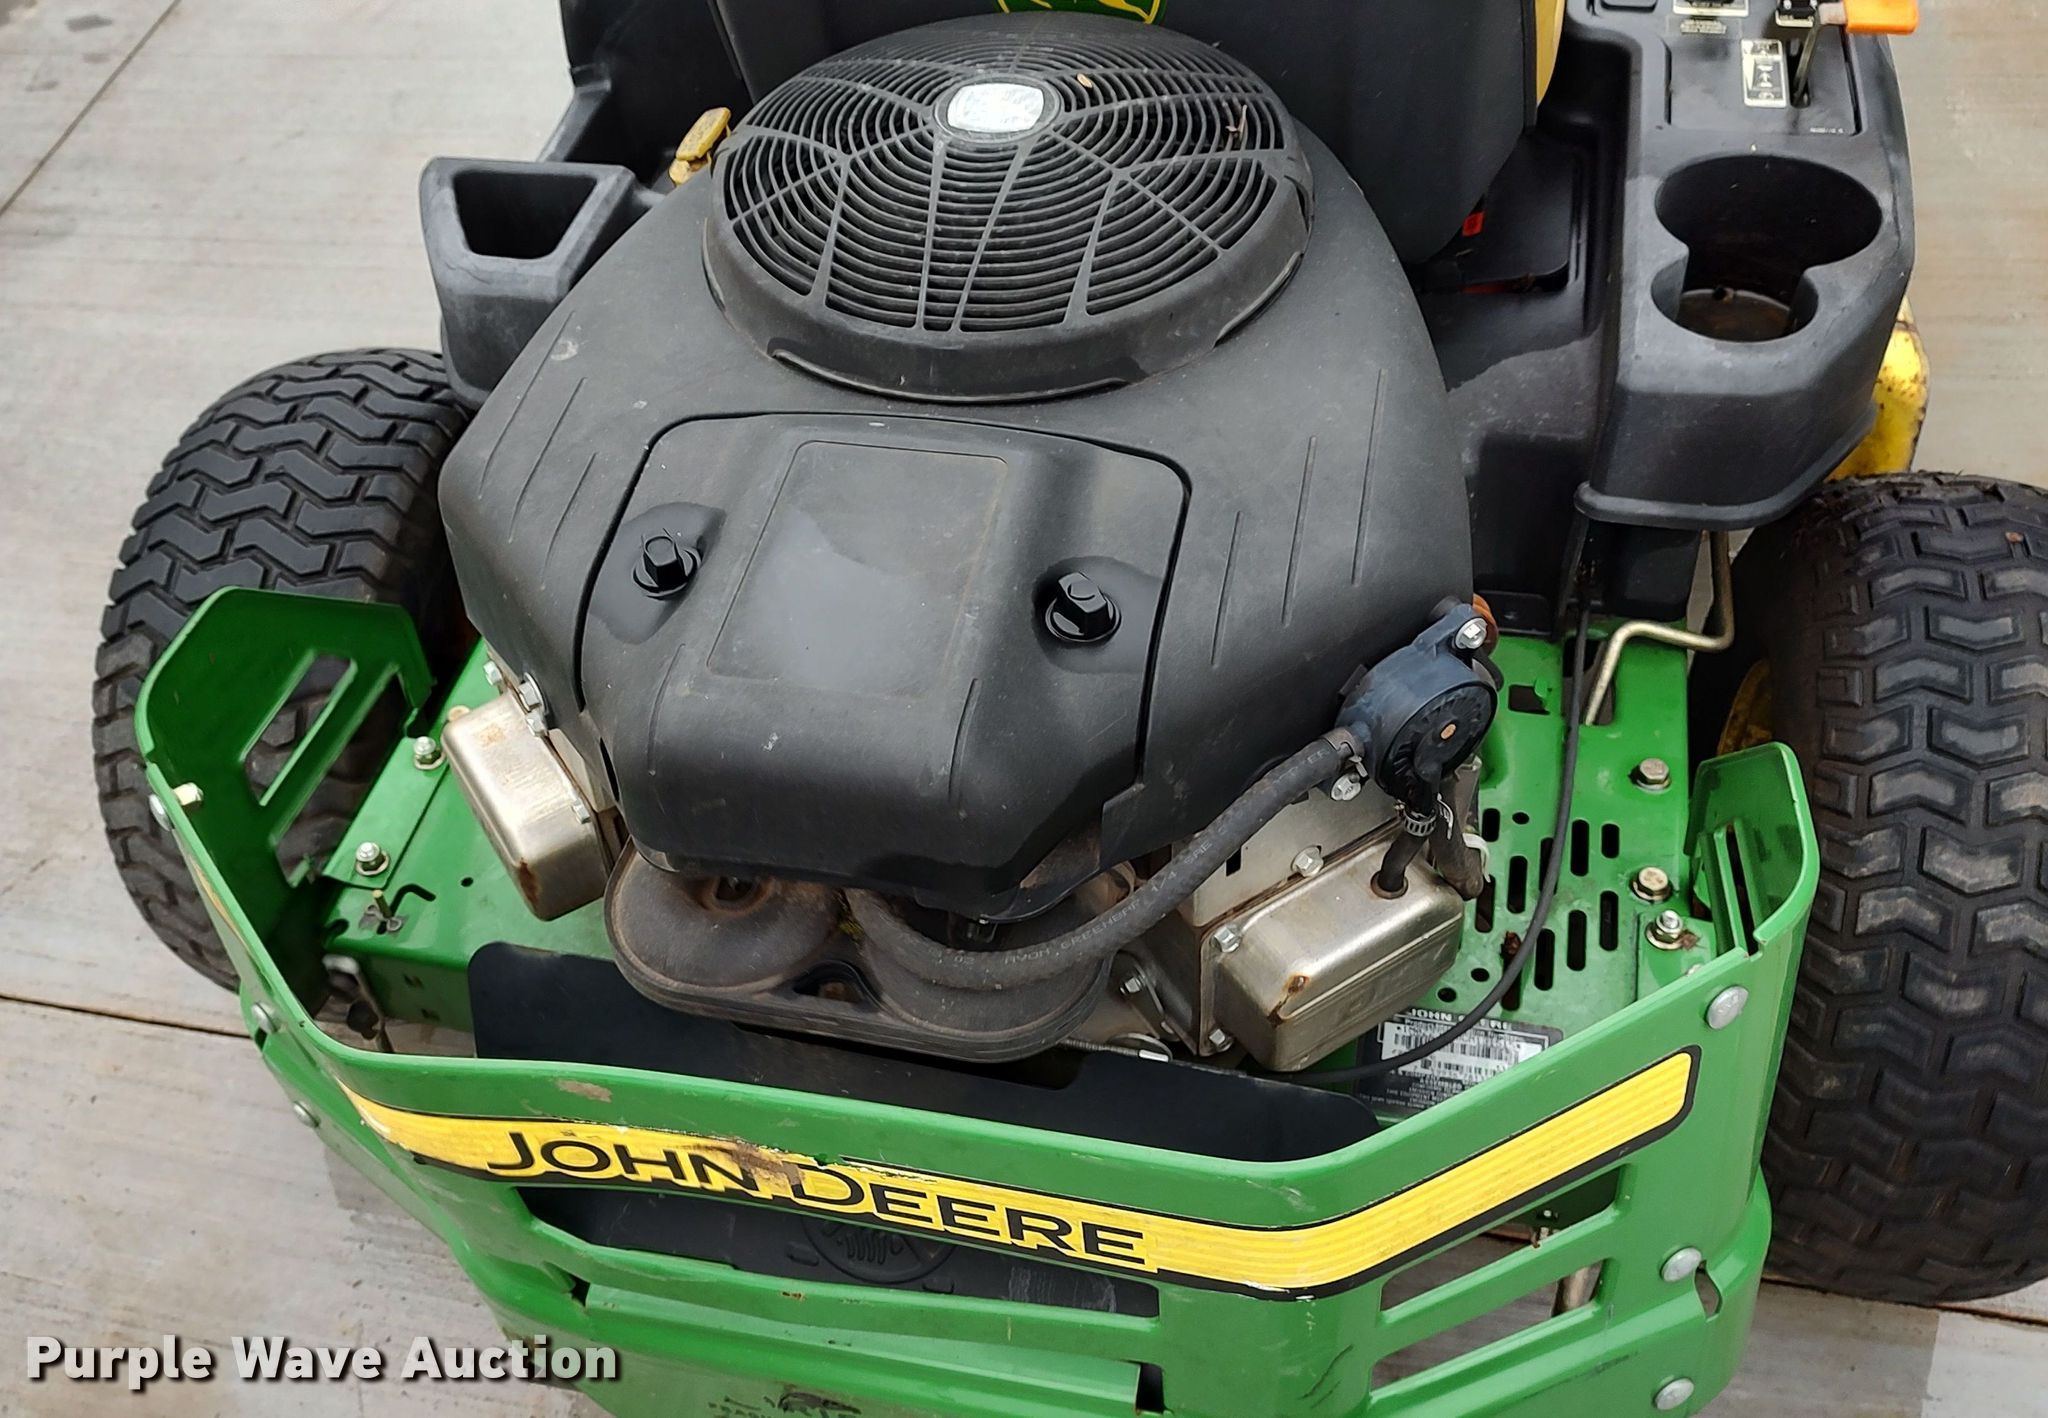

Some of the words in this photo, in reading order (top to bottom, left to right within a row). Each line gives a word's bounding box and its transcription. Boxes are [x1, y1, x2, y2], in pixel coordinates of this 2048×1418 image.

[1405, 1008, 1453, 1023] JOHN
[486, 1130, 761, 1194] JOHN
[781, 1159, 1147, 1266] DEERE
